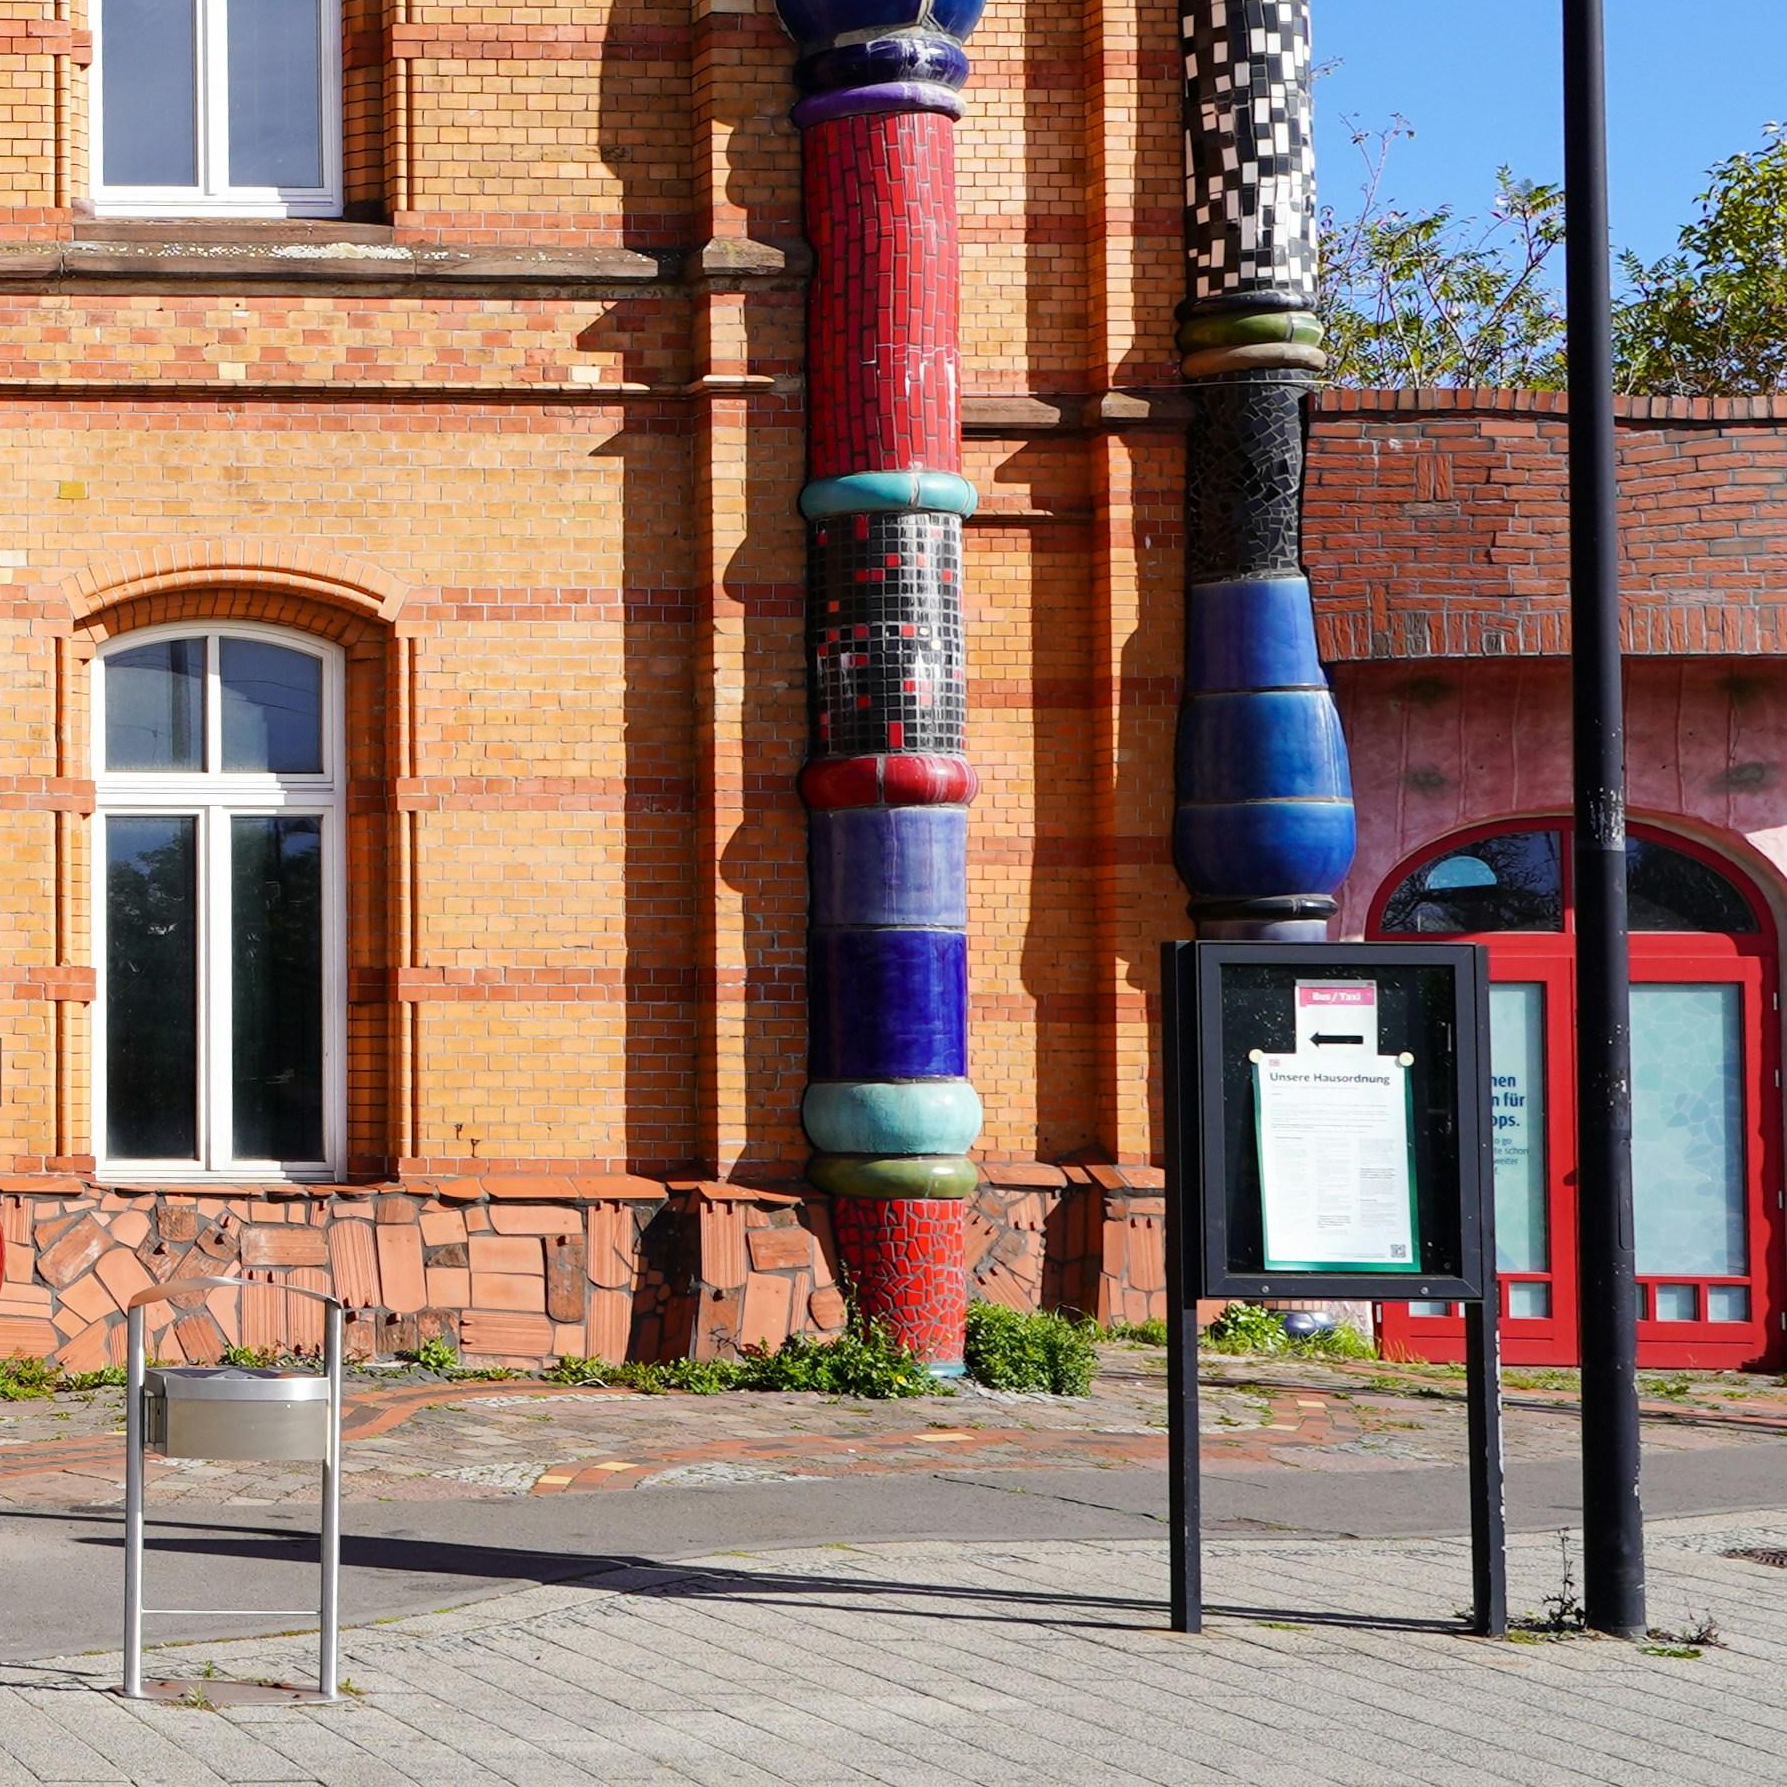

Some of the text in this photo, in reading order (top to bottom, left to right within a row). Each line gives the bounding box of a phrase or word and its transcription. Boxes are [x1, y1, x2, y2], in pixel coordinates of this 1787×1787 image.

[1270, 1073, 1390, 1085] Unsere Hausordnung
[1503, 1092, 1525, 1107] für
